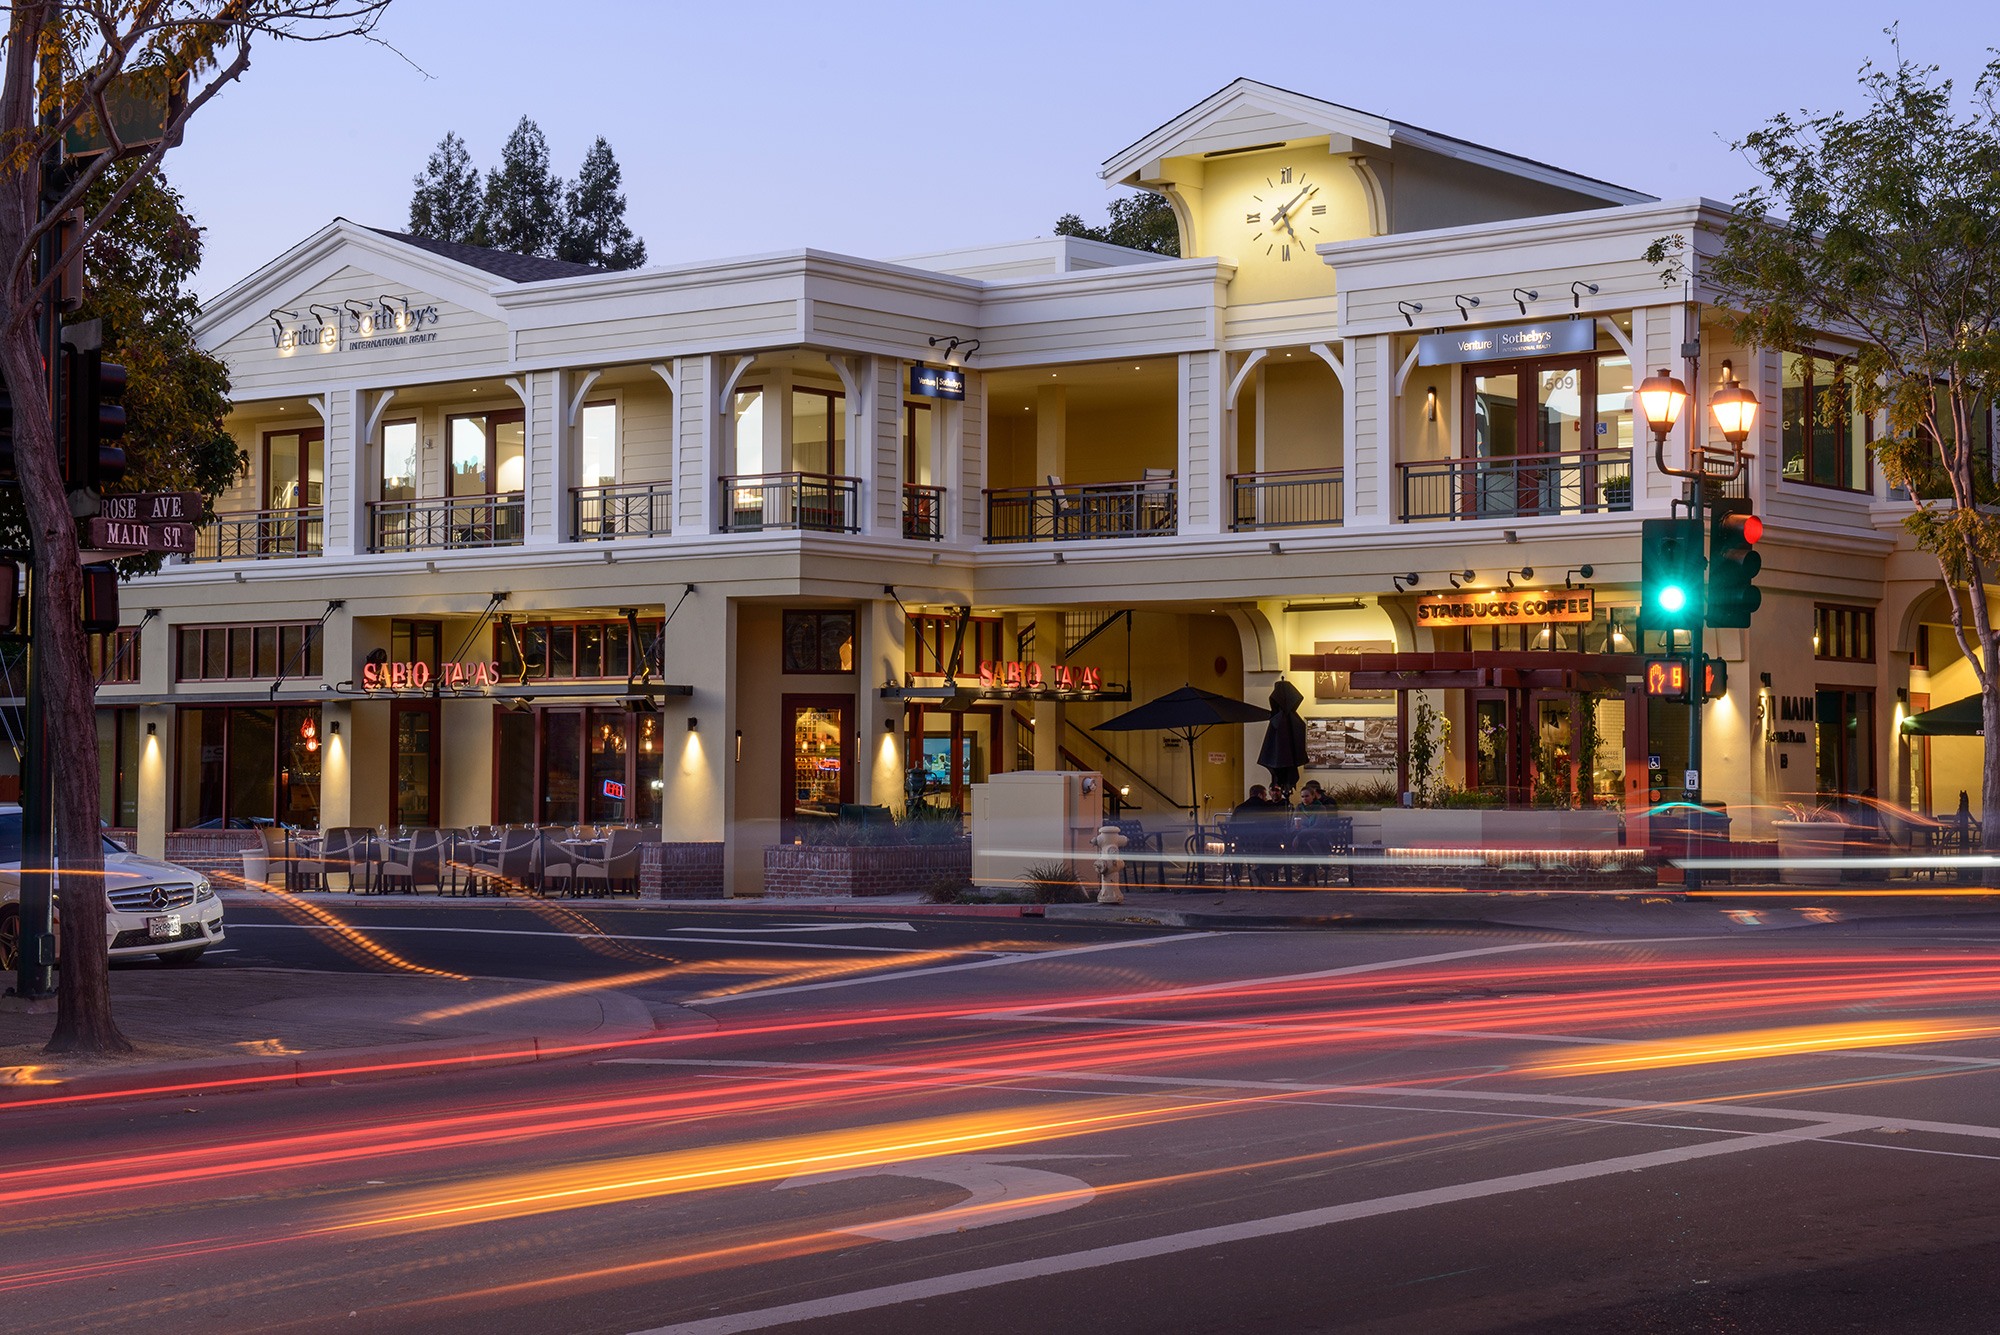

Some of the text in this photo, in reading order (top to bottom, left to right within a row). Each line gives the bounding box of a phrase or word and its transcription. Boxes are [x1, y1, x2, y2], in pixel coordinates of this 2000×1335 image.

[272, 304, 439, 352] Venture Sotheby's
[1457, 329, 1552, 351] Venture Sotheby's
[350, 332, 438, 351] INTERNATIONAL REALTY
[1545, 376, 1574, 391] 509
[101, 496, 184, 519] ROSE AVE.
[107, 522, 183, 548] MAIN ST.
[1419, 598, 1589, 619] STARBUCKS COFFEE
[441, 661, 499, 687] TAPAS
[1050, 665, 1102, 690] TAPAS
[1781, 695, 1814, 721] MAIN
